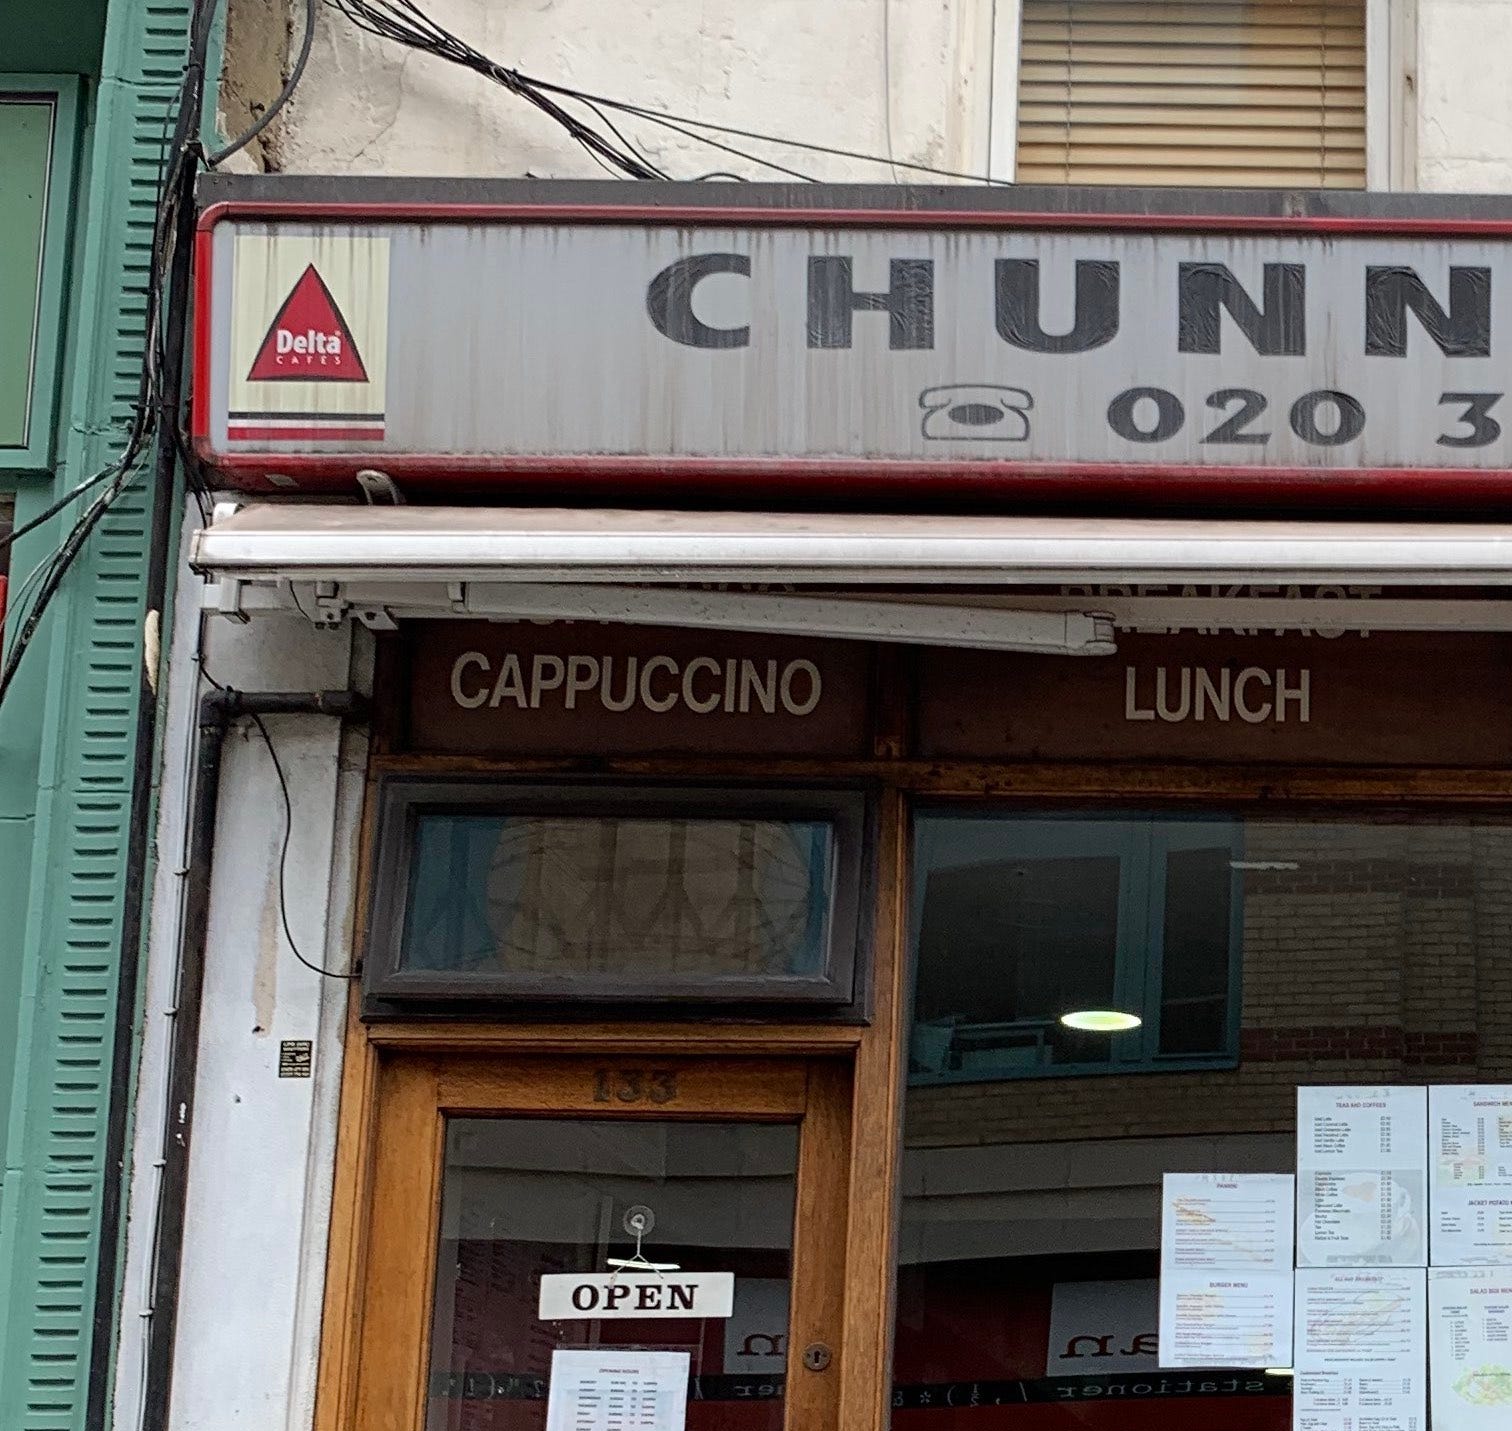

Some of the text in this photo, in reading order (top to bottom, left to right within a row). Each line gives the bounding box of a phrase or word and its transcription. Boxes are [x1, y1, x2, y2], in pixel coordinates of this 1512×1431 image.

[277, 329, 341, 354] Delta
[1107, 386, 1366, 447] 020
[450, 651, 822, 716] CAPPUCCINO
[1126, 667, 1310, 722] LUNCH
[593, 1071, 679, 1103] 133
[572, 1284, 700, 1311] OPEN
